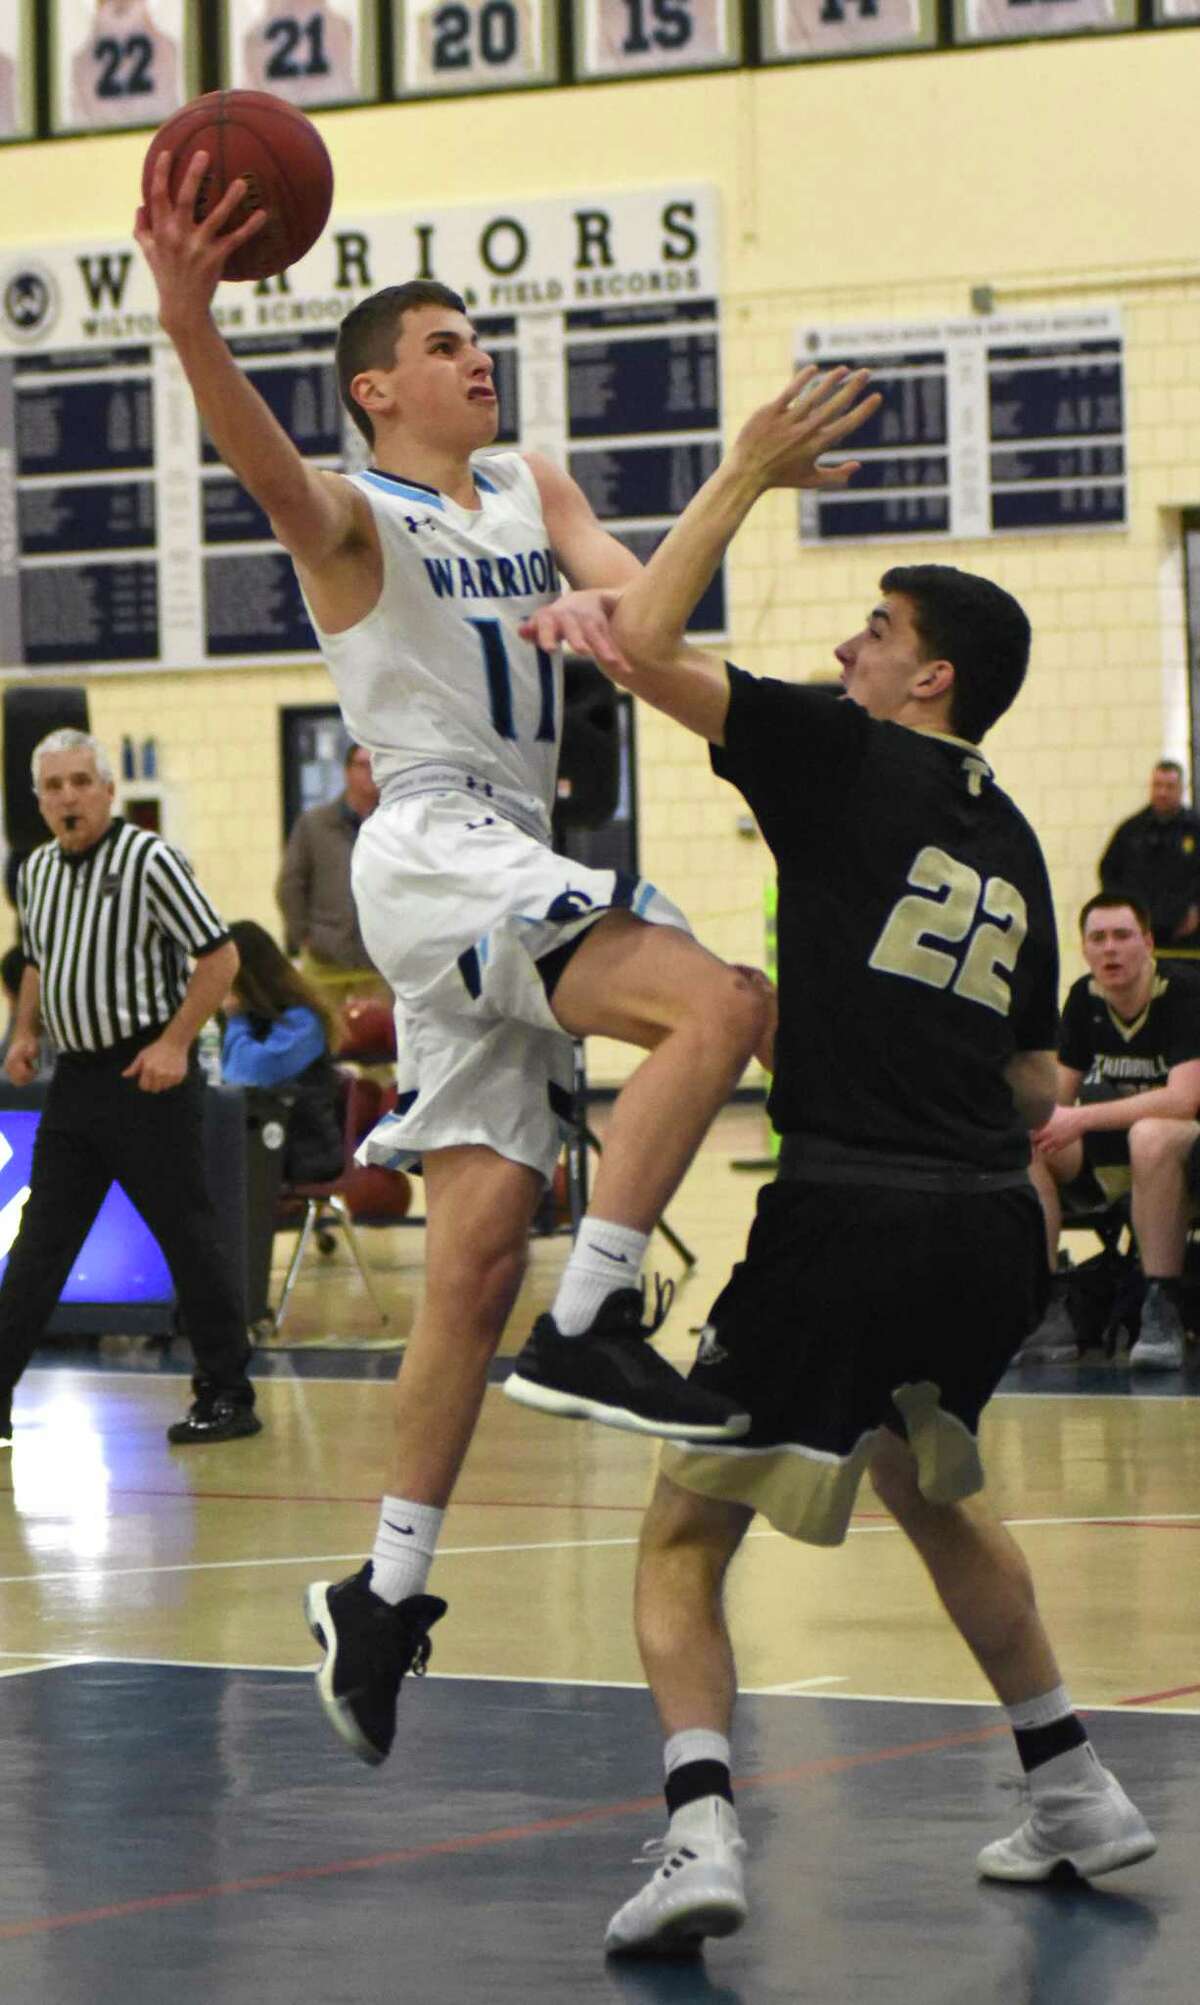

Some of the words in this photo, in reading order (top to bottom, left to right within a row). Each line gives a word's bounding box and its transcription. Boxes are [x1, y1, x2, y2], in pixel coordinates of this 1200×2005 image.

[94, 34, 154, 97] 22
[264, 13, 329, 79] 21
[432, 0, 518, 70] 20
[77, 201, 699, 308] WRIORS
[82, 313, 156, 337] WILTO
[490, 279, 563, 304] FIELD
[575, 269, 699, 298] RECORDS
[868, 846, 1028, 1017] 22
